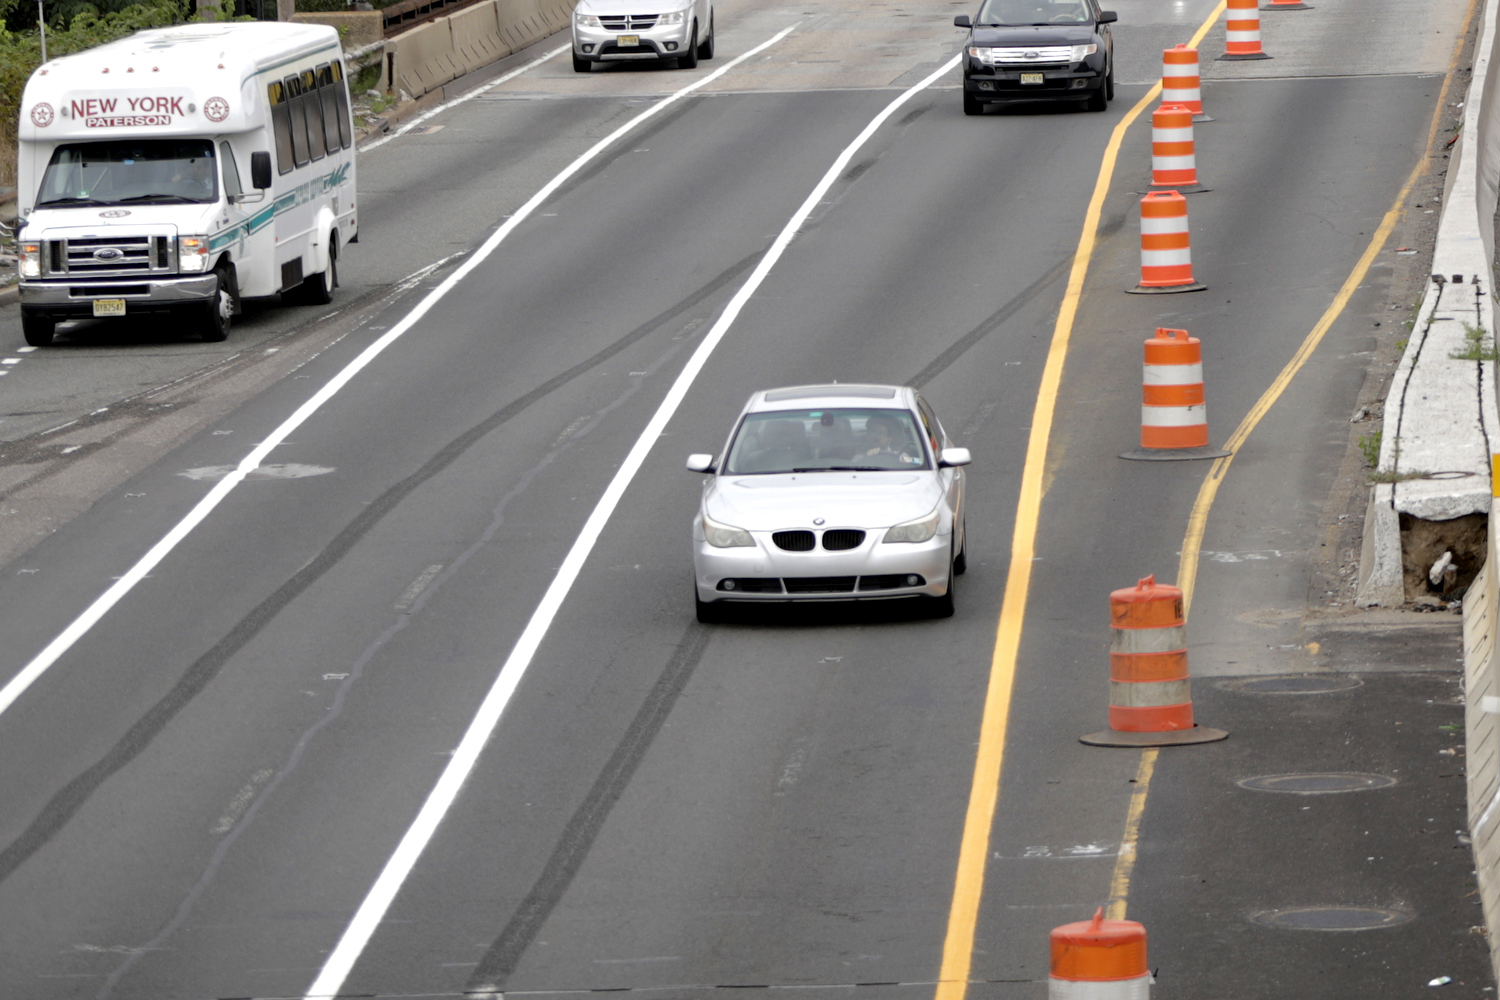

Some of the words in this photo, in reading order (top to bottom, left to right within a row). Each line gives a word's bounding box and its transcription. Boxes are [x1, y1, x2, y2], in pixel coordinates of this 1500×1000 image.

[71, 98, 118, 120] NEW
[127, 96, 185, 117] YORK
[87, 116, 170, 127] PATERSON
